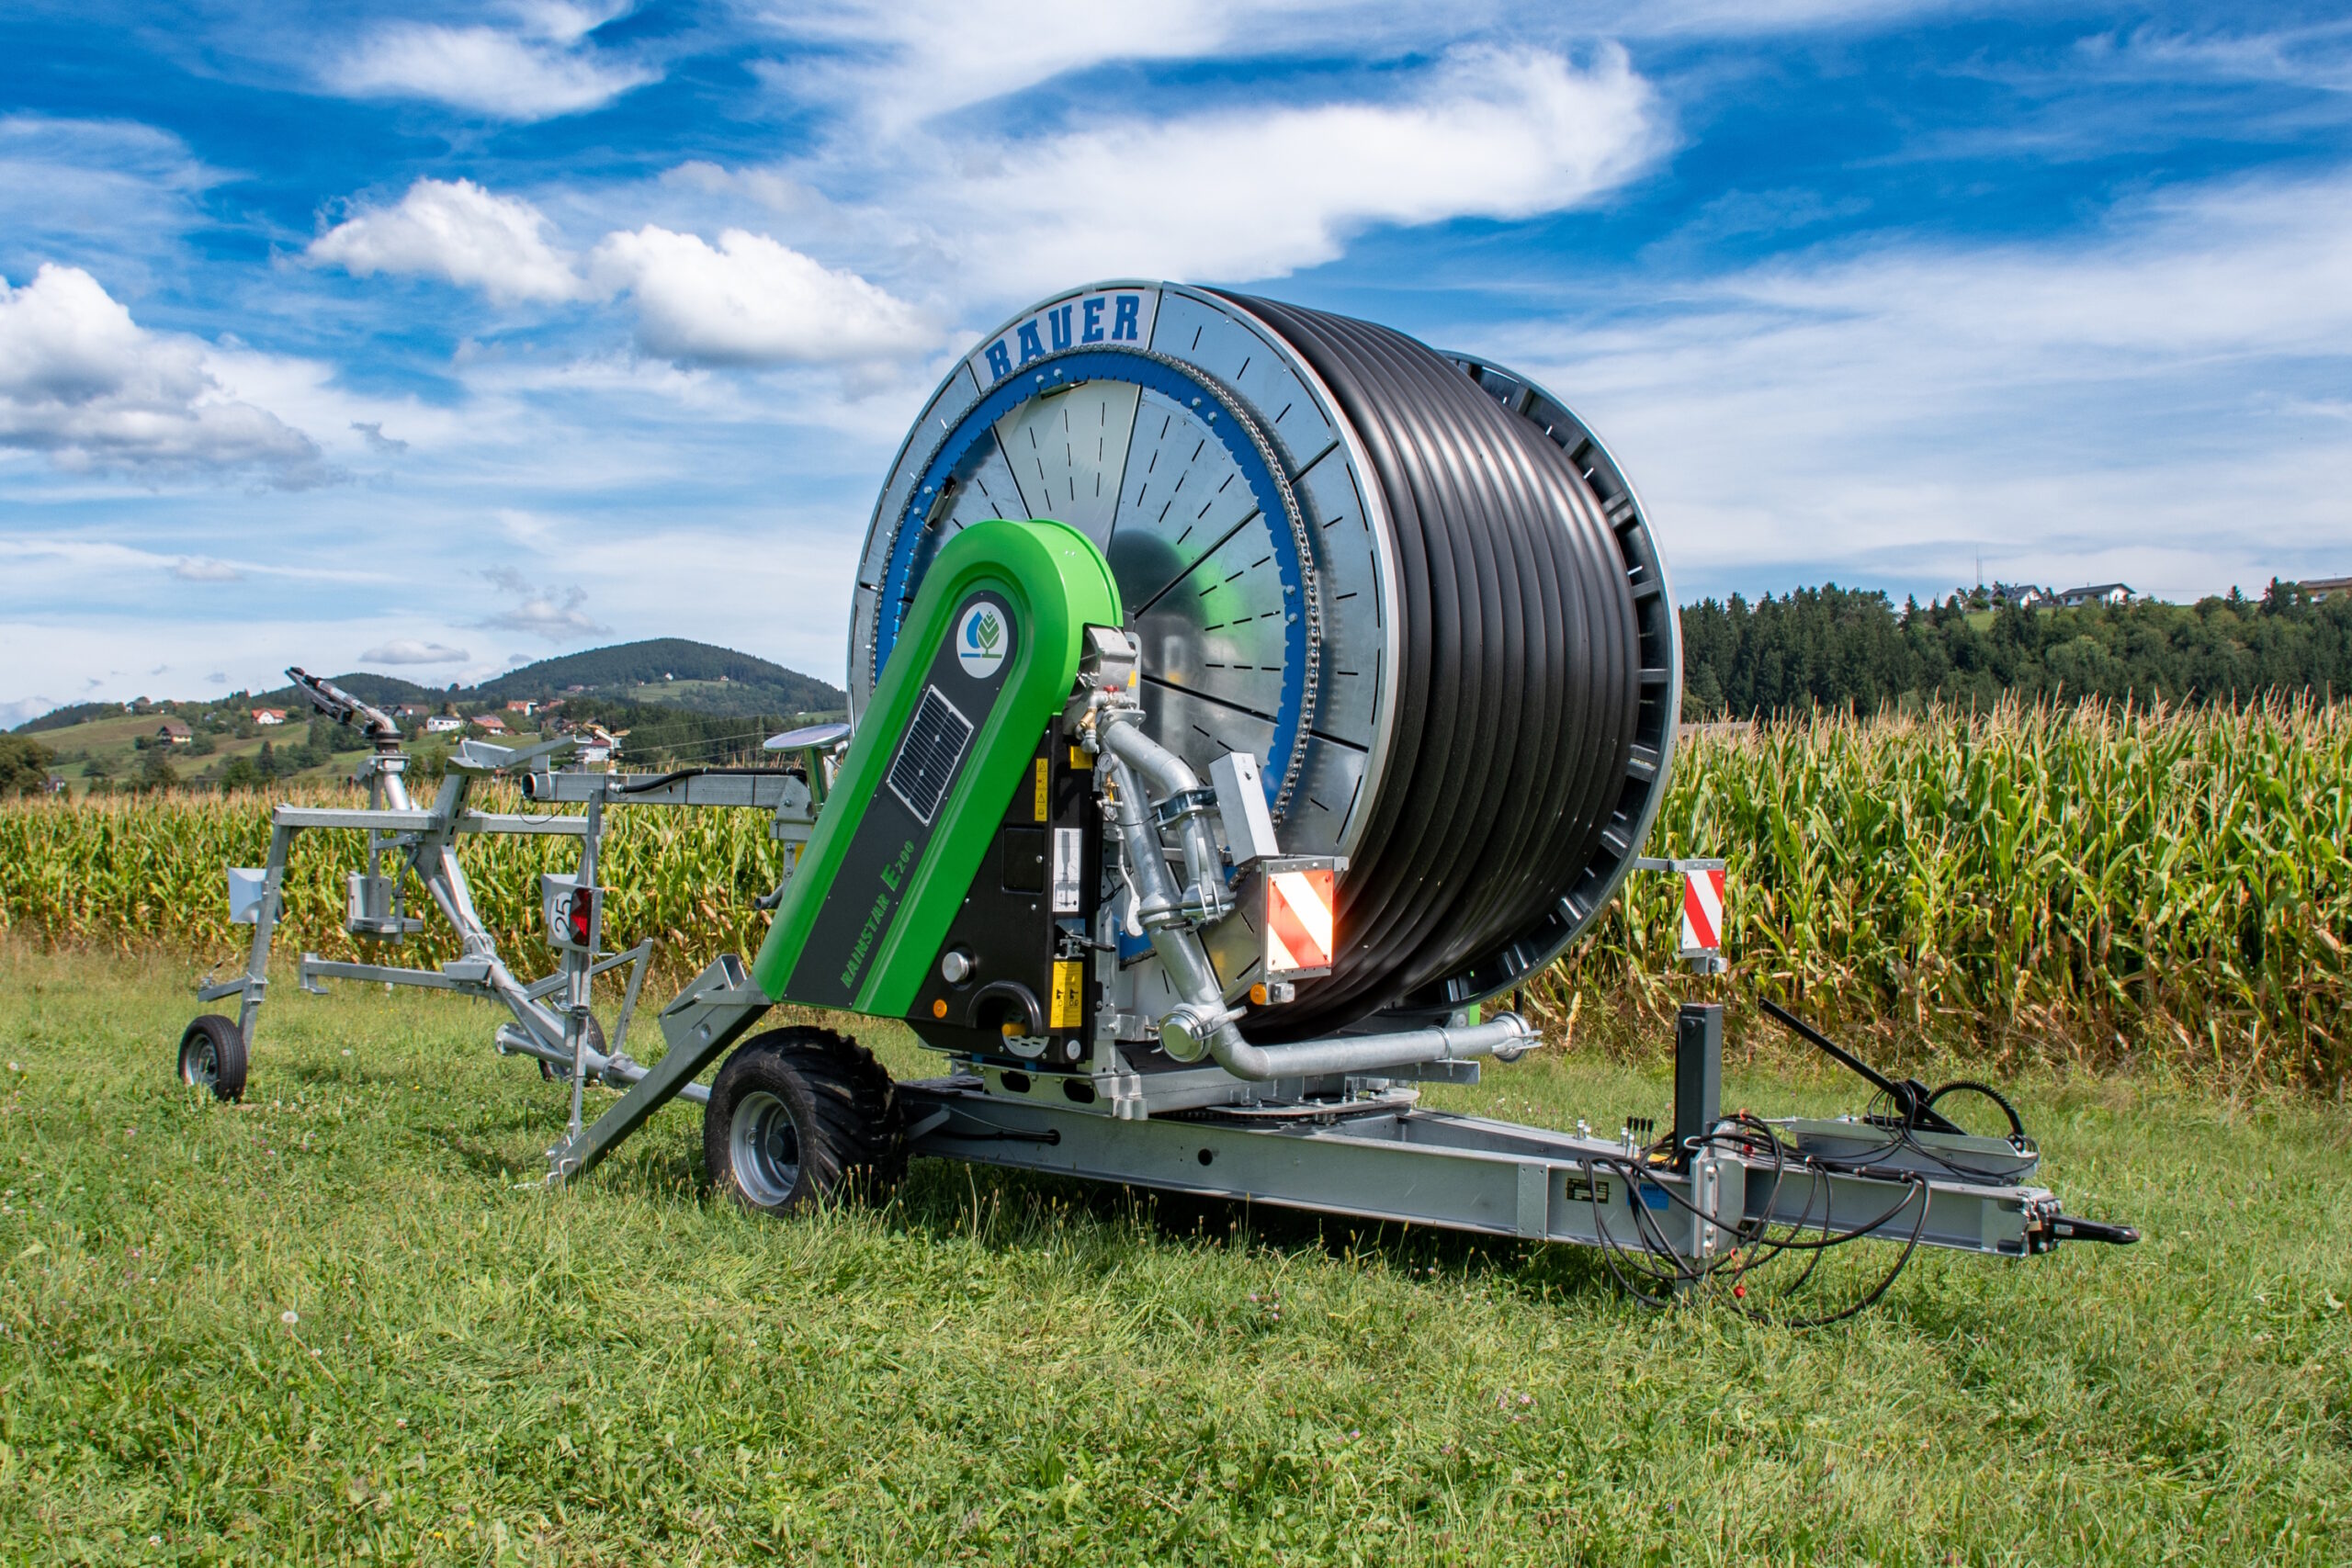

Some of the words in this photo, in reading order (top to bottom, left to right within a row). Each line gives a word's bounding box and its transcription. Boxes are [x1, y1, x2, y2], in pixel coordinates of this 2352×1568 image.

[985, 295, 1140, 381] BAUER
[555, 898, 571, 934] 25
[840, 892, 890, 989] RAINSTAR
